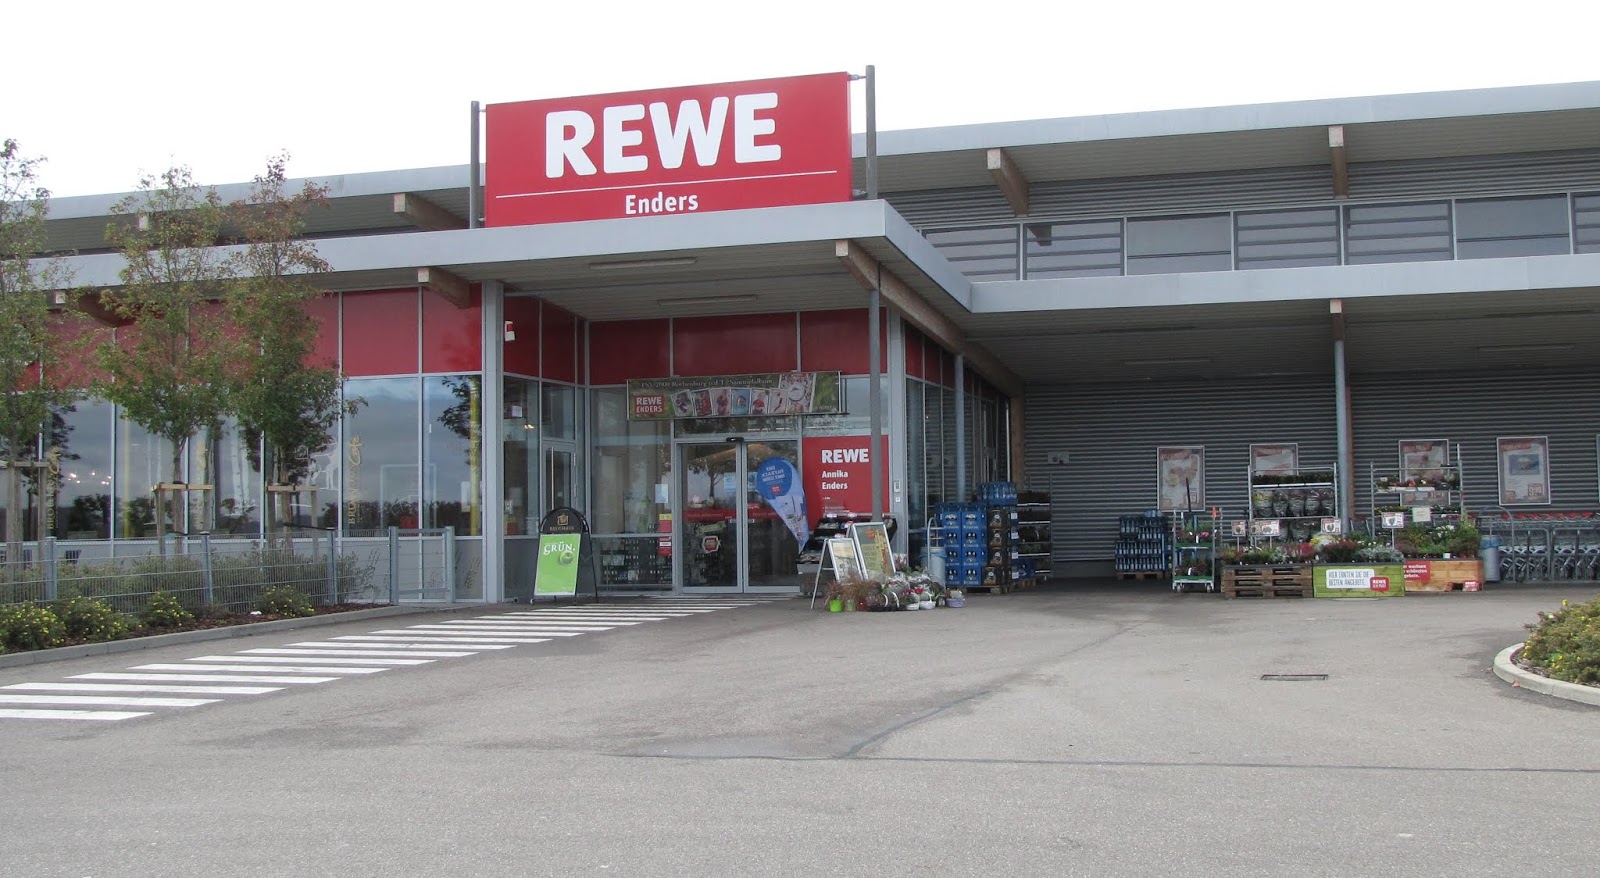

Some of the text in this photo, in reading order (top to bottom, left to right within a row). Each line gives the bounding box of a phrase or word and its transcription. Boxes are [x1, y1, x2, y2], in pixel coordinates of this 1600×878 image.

[545, 92, 782, 179] REWE
[625, 191, 699, 215] Enders
[636, 396, 662, 405] REWE
[636, 405, 663, 413] ENDERS
[821, 448, 869, 464] REWE
[821, 470, 849, 479] Annika
[821, 481, 848, 490] Enders
[543, 541, 576, 556] GRÜN.
